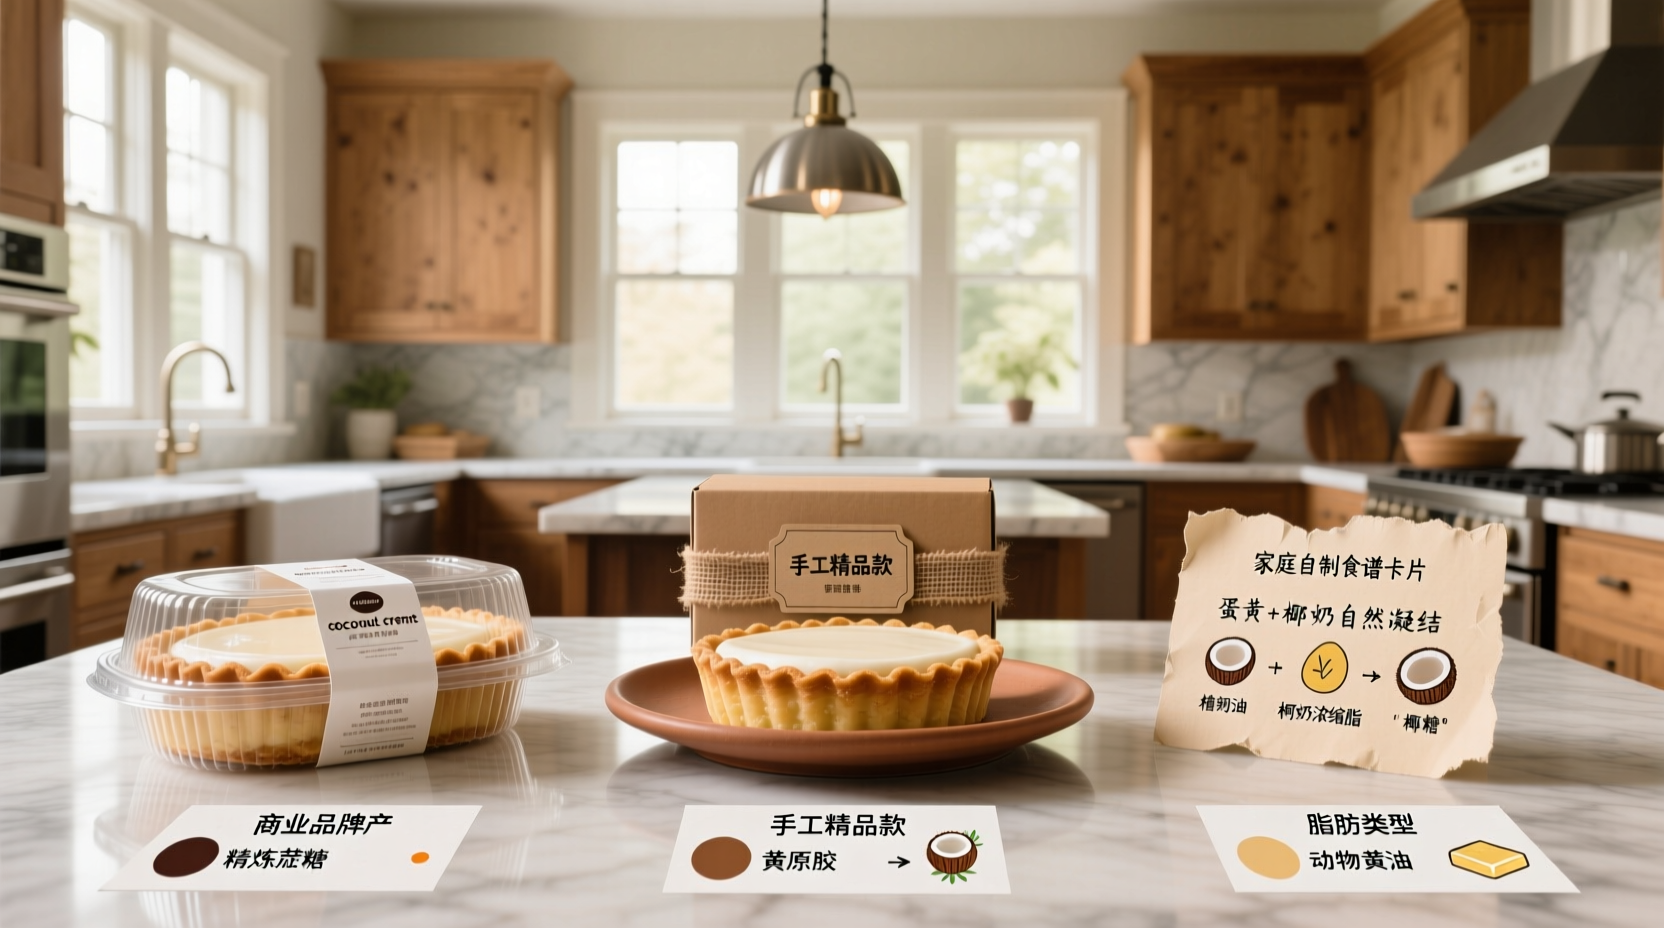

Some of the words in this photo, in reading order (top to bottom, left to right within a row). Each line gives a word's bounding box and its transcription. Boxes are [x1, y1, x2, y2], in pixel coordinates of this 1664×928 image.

[790, 553, 892, 576] 手工精品款
[1255, 551, 1425, 582] 家庭自制食谱卡片
[254, 813, 393, 835] 商业品牌产
[771, 813, 905, 836] 手工精品款
[1307, 813, 1417, 835] 脂肪类型
[763, 850, 836, 871] 黄原胶
[1310, 850, 1413, 870] 动物黄油
